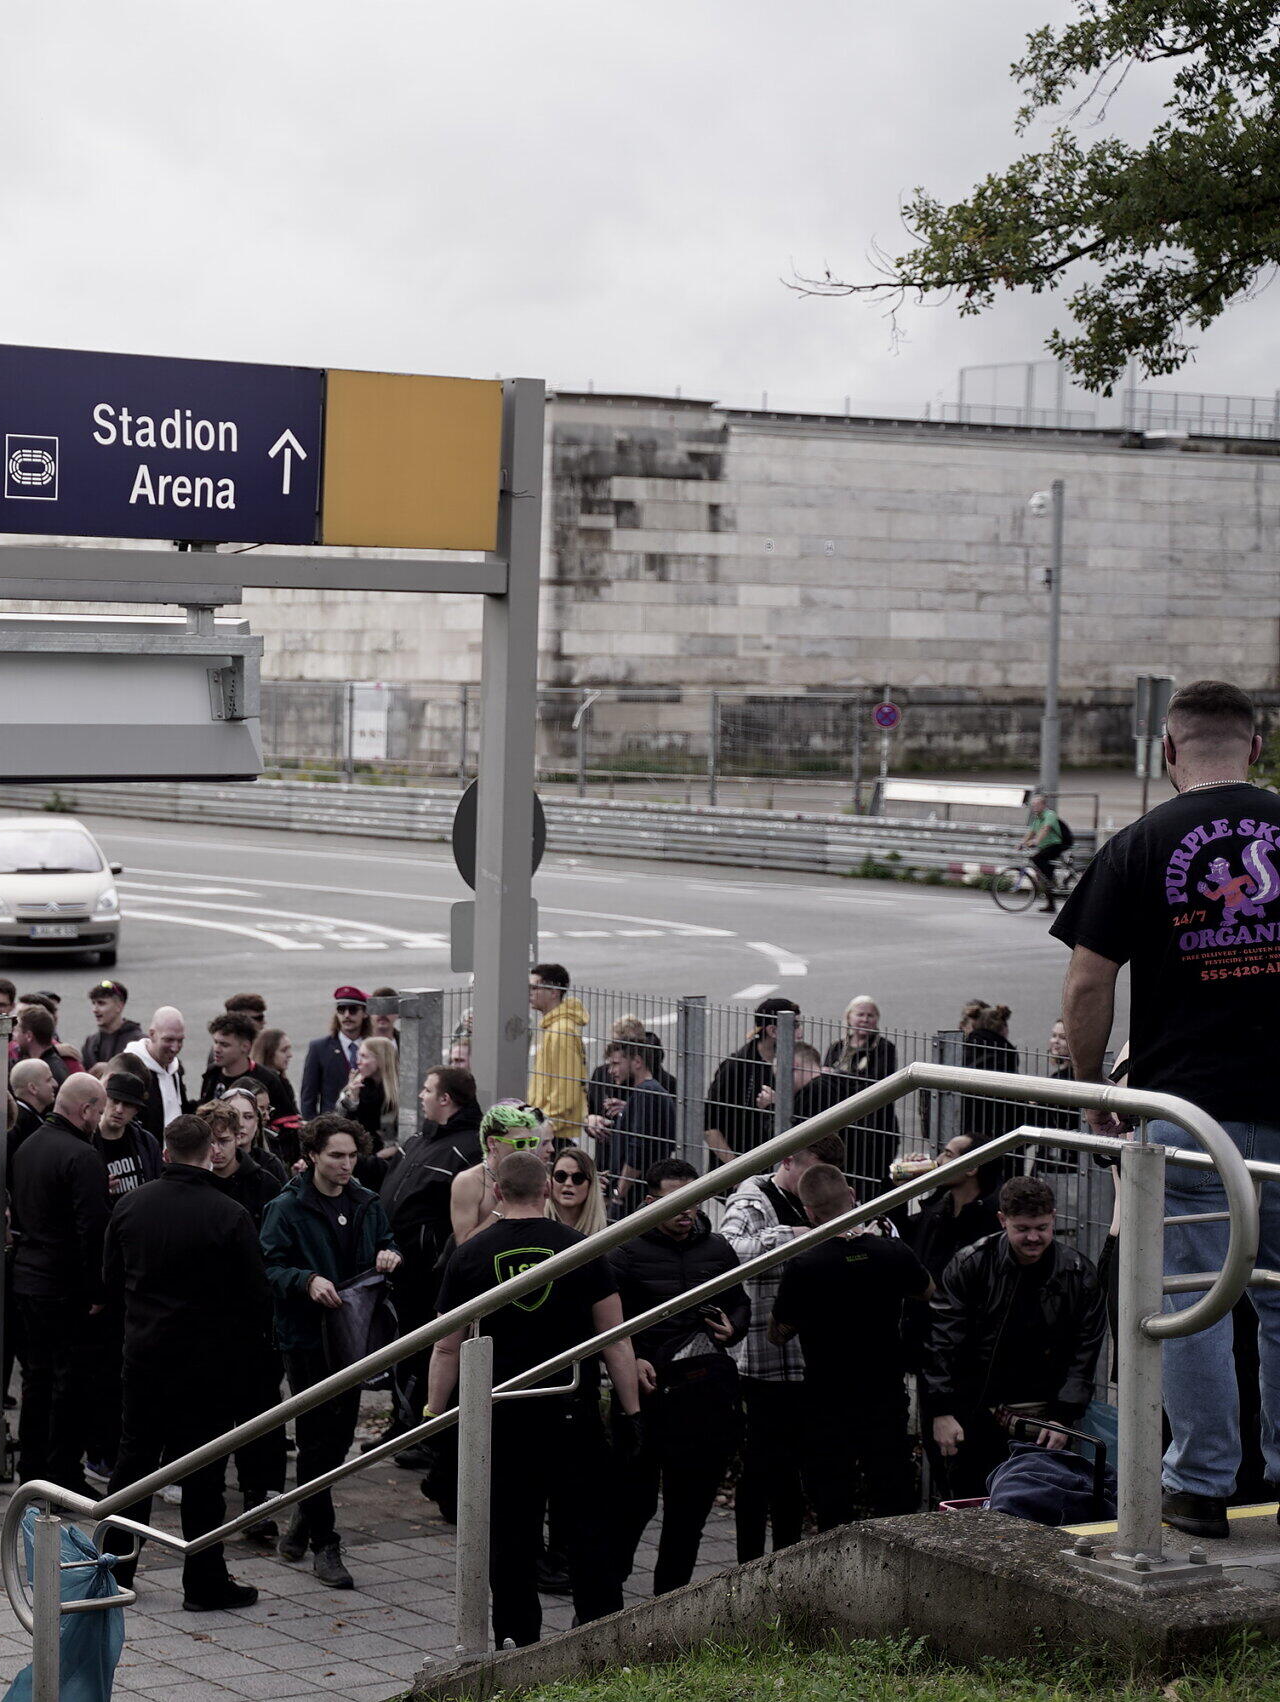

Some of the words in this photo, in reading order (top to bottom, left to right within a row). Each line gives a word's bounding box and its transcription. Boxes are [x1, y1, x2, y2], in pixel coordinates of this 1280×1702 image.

[93, 403, 237, 452] Stadion
[129, 464, 235, 509] Arena
[1166, 819, 1233, 905] PURPLE
[1237, 819, 1280, 849] SK
[1172, 909, 1206, 926] 24/7
